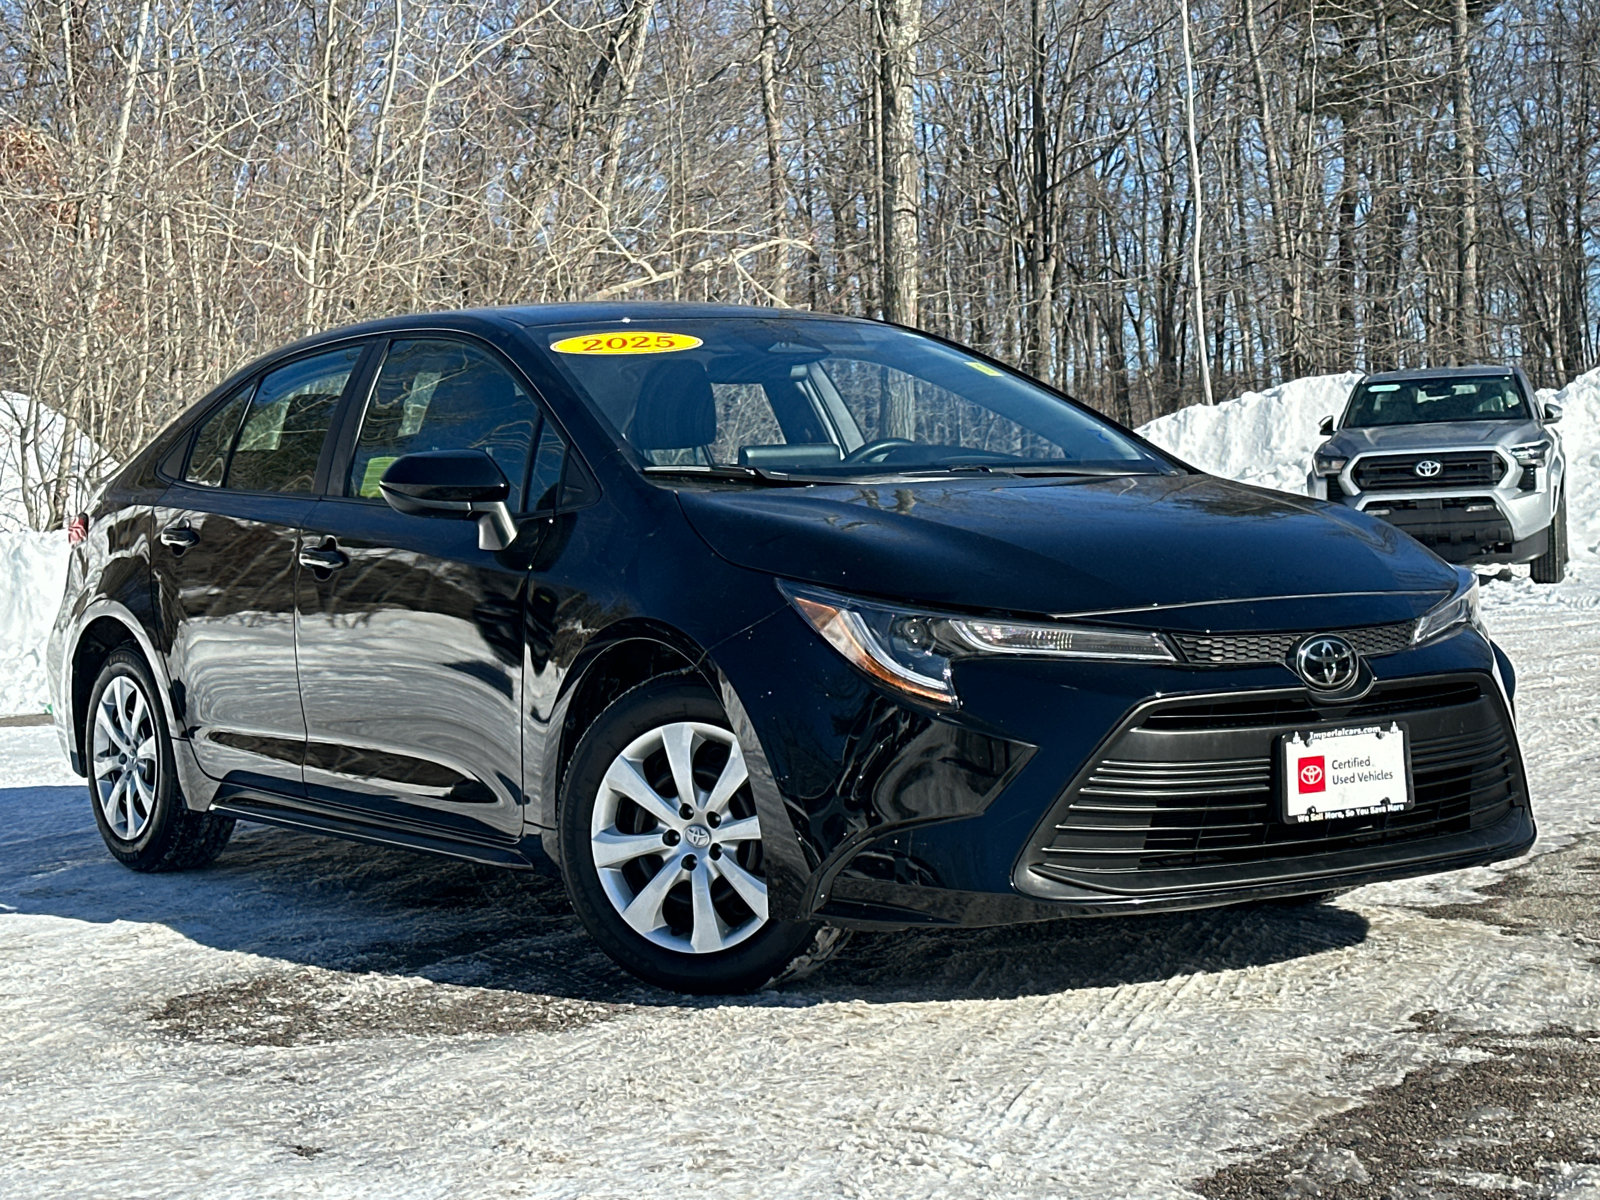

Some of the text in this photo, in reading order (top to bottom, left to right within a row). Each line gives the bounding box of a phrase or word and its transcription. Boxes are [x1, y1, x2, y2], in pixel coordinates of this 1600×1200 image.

[582, 336, 675, 351] 2025
[1332, 755, 1371, 770] Certified
[1332, 769, 1393, 785] Used Vehicles
[1297, 815, 1309, 823] We
[1310, 813, 1324, 822] Sell
[1346, 809, 1355, 817] So
[1356, 806, 1370, 815] You
[1371, 805, 1387, 813] Save
[1388, 803, 1404, 811] More
